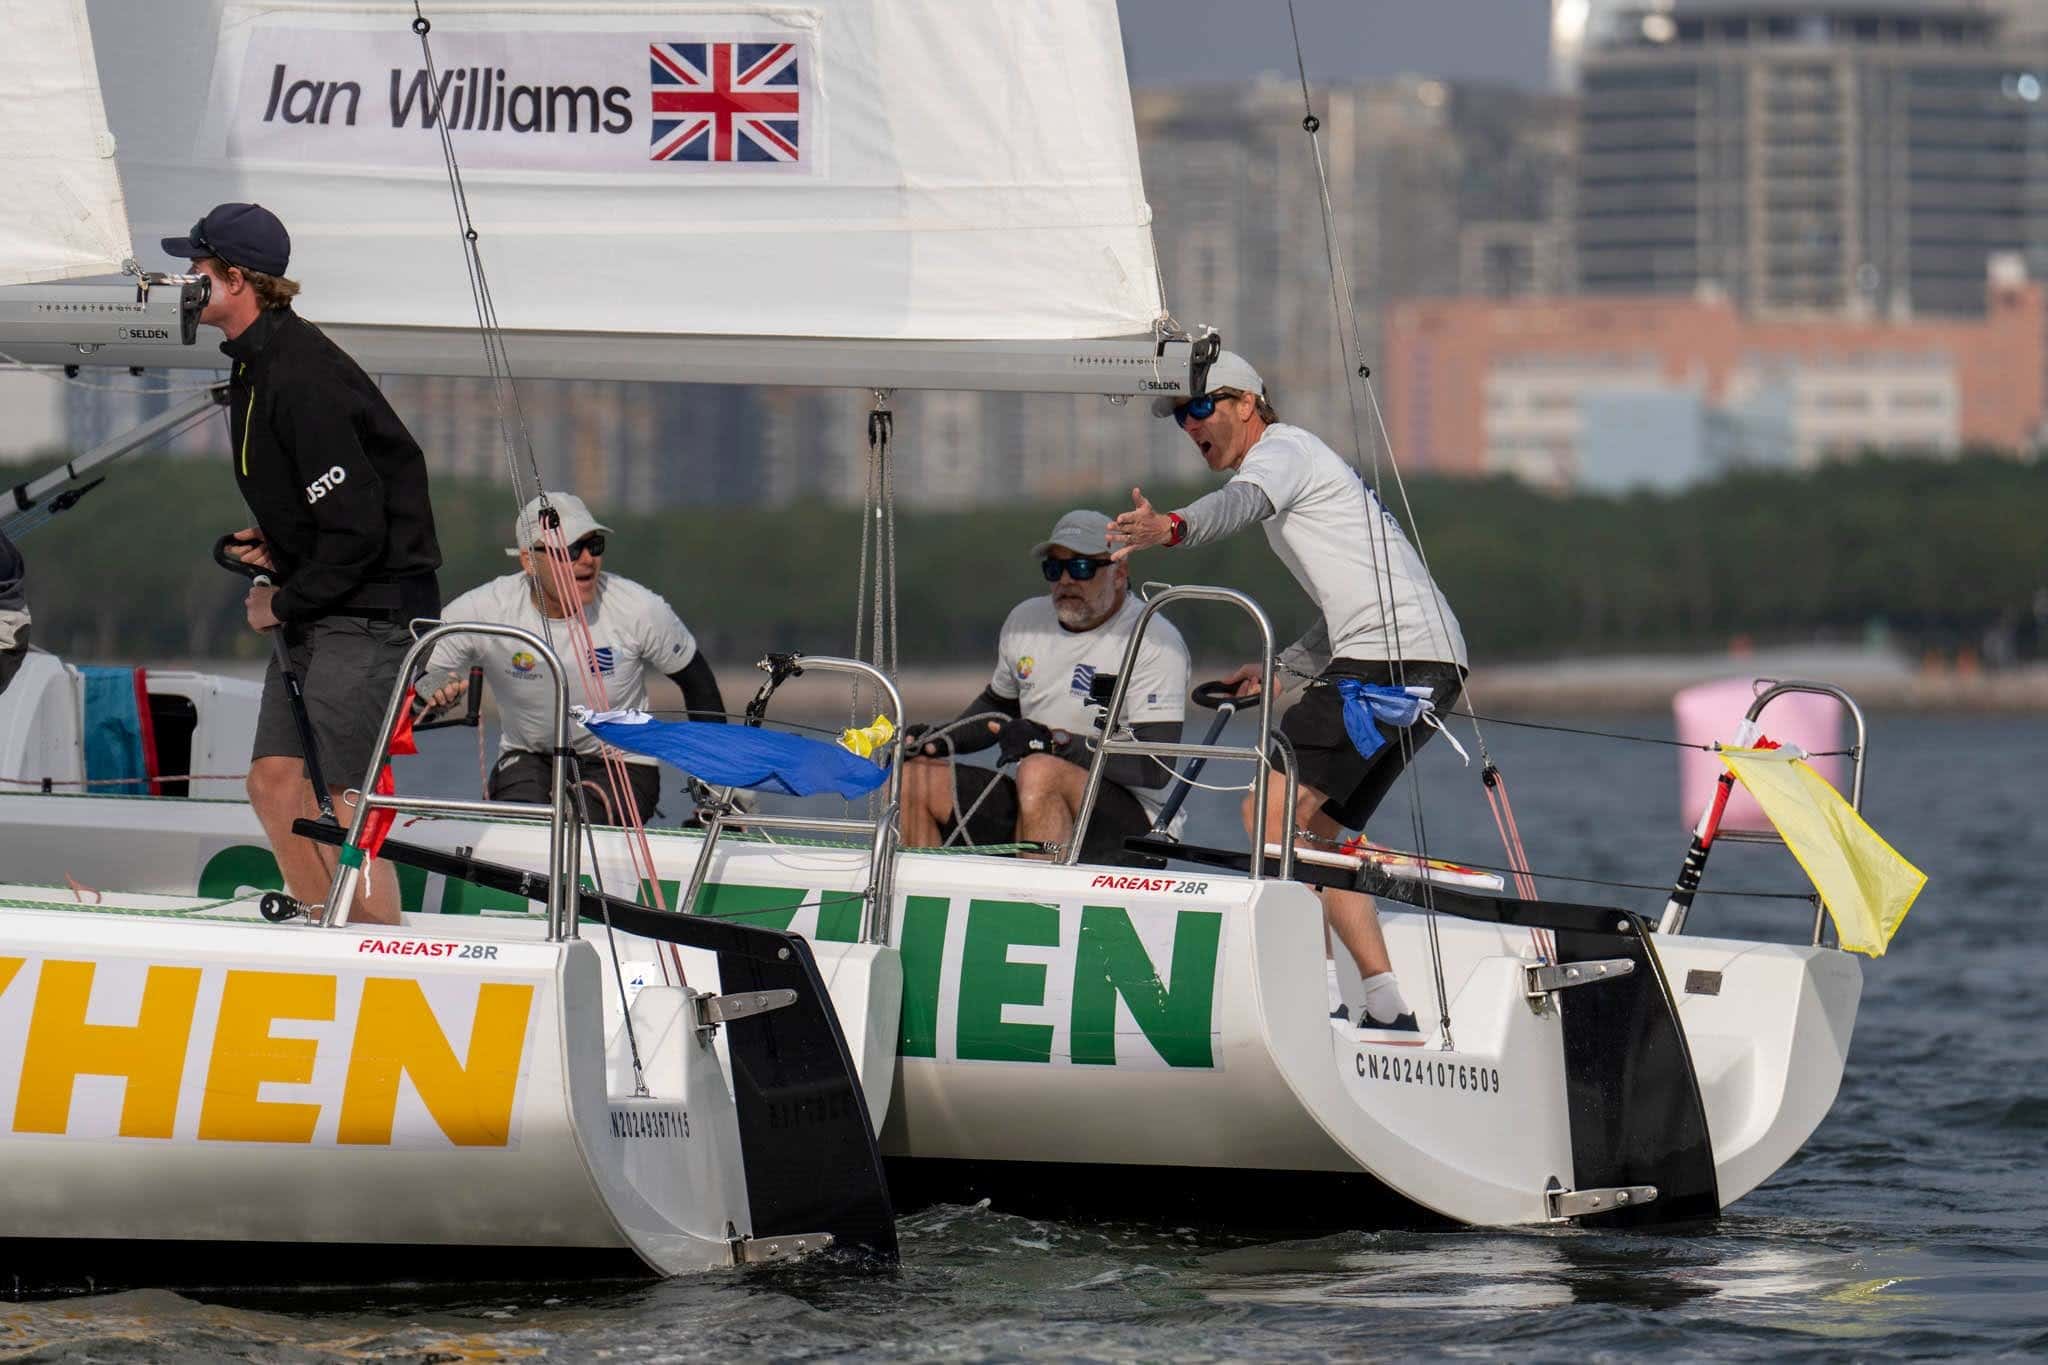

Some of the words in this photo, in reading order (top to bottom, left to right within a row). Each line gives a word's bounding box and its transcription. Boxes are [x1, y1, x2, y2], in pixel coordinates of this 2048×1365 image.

[263, 63, 361, 126] Ian
[390, 67, 633, 134] Williams
[306, 465, 346, 504] USTO
[1091, 875, 1176, 892] FAREAST
[1173, 881, 1208, 895] 28R
[358, 939, 458, 957] FAREAST
[458, 944, 498, 960] 28R
[0, 956, 535, 1147] HEN
[1356, 1052, 1500, 1093] CN20241076509
[609, 1111, 690, 1138] N20249367115
